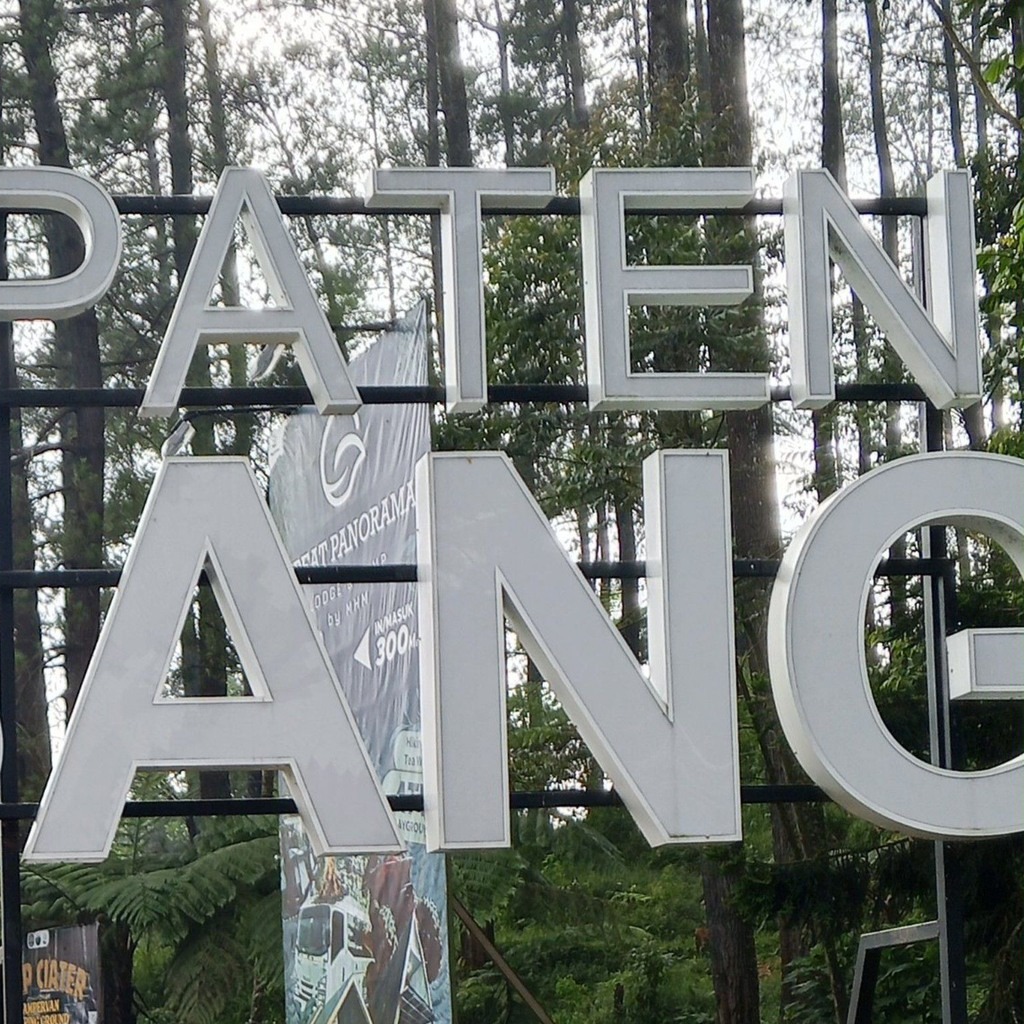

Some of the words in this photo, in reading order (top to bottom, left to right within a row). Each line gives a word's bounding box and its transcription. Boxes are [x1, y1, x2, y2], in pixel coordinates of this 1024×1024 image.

[330, 479, 417, 562] PANORAMA
[327, 610, 341, 627] by
[374, 602, 414, 636] IN/MASUK
[375, 624, 409, 666] 300
[37, 959, 88, 1001] CIATER
[23, 999, 60, 1015] AMPERVAN
